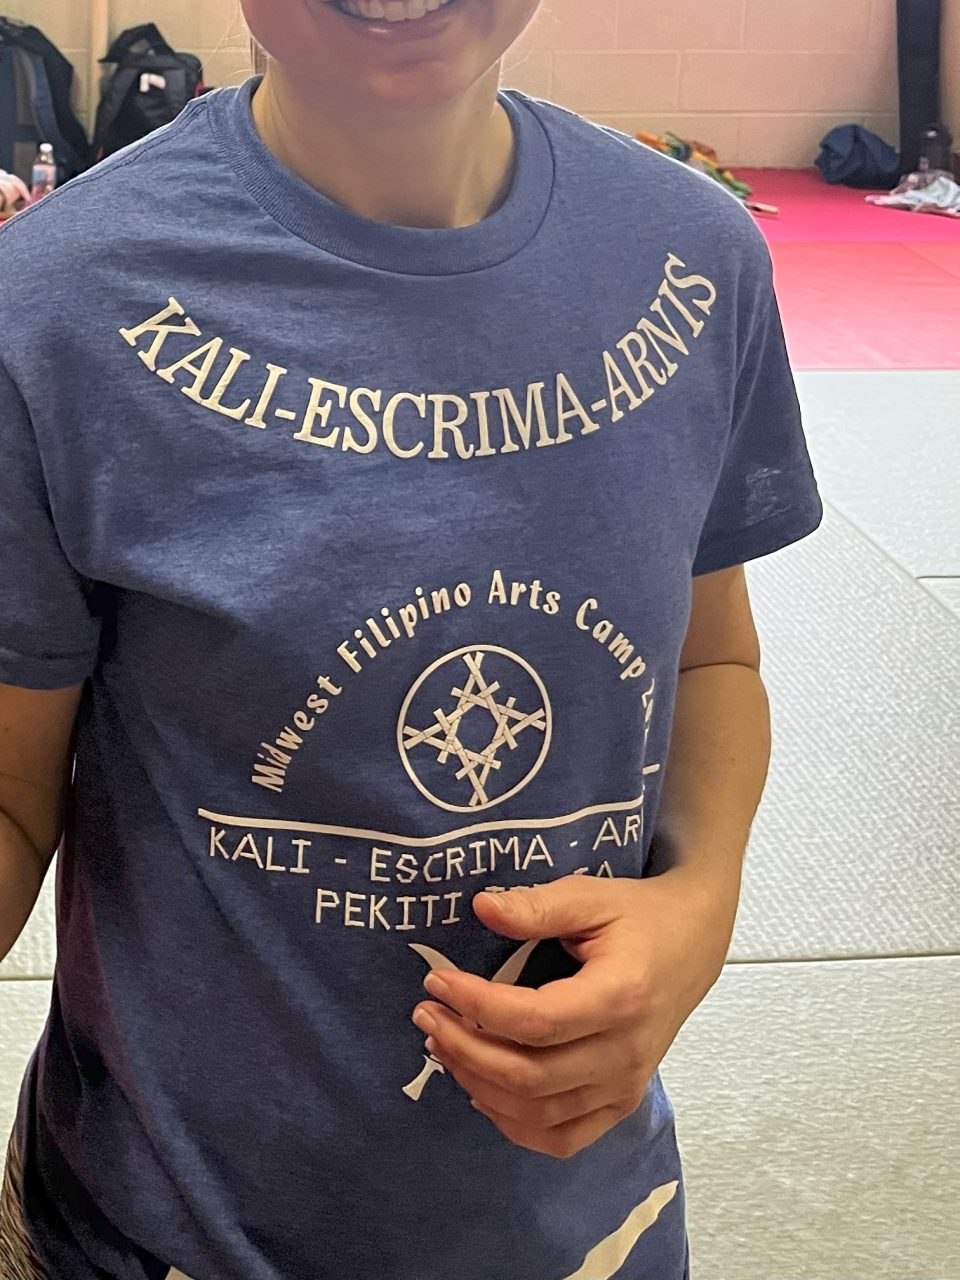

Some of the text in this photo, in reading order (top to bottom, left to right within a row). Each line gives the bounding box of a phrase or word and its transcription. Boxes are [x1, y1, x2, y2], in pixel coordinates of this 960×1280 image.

[118, 252, 718, 460] KALI-ESCRIMA-ARNIS
[251, 569, 646, 793] Midwest Filipino Arts Camp
[209, 826, 312, 874] KALI
[370, 834, 554, 884] ESCRIMA
[592, 814, 642, 851] AR
[315, 888, 462, 931] PEKITI
